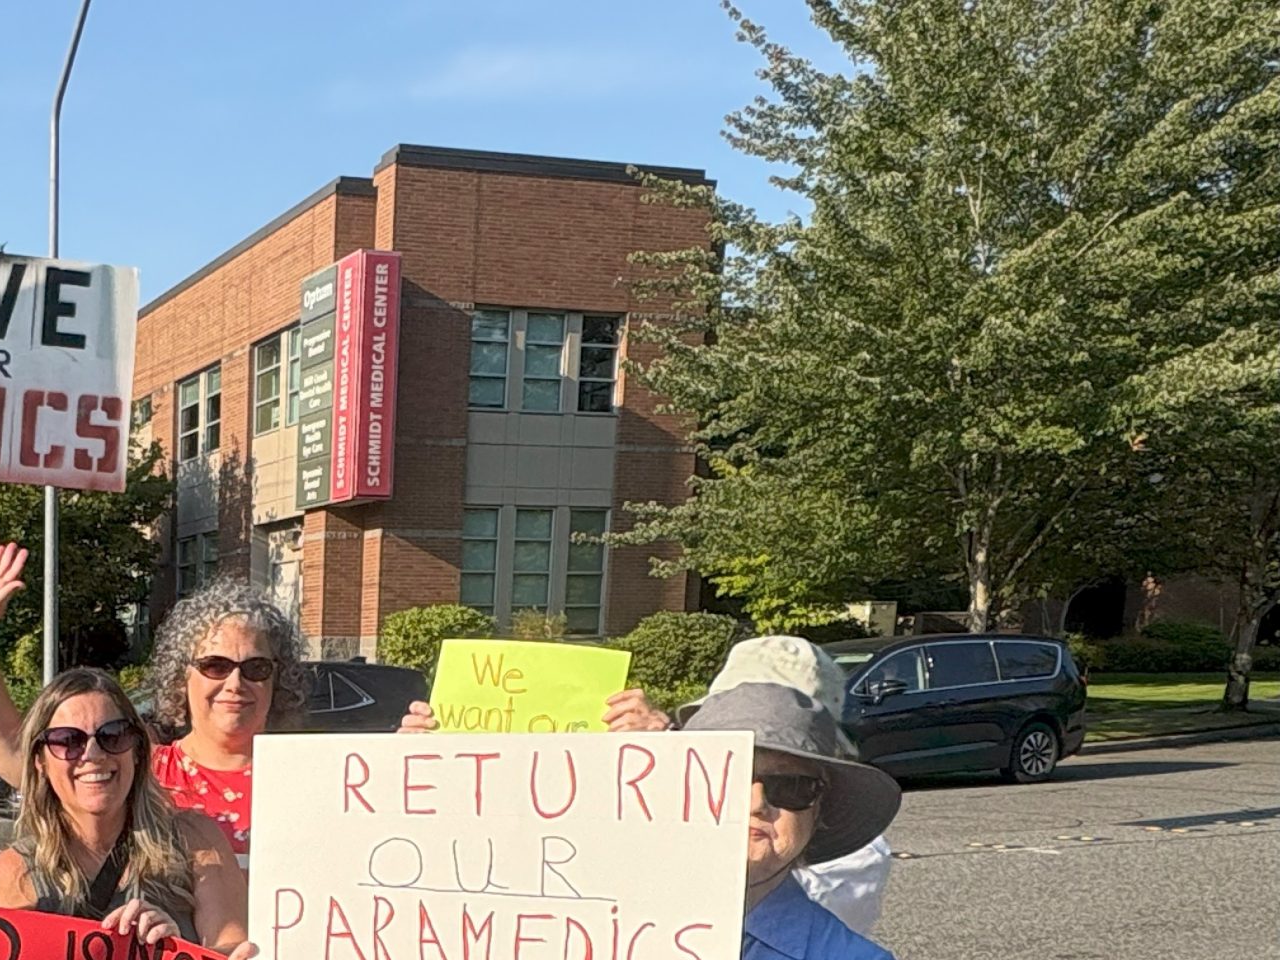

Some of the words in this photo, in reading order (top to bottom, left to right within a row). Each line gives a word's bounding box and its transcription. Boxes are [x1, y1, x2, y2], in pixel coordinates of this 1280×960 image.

[373, 263, 389, 328] CENTER
[339, 334, 350, 411] MEDICAL
[370, 332, 386, 408] MEDICAL
[336, 416, 347, 489] SCHMIDT
[366, 412, 382, 487] SCHMIDT
[471, 653, 527, 694] We
[439, 697, 515, 733] want
[344, 744, 734, 826] RETURN
[368, 836, 583, 899] OUR
